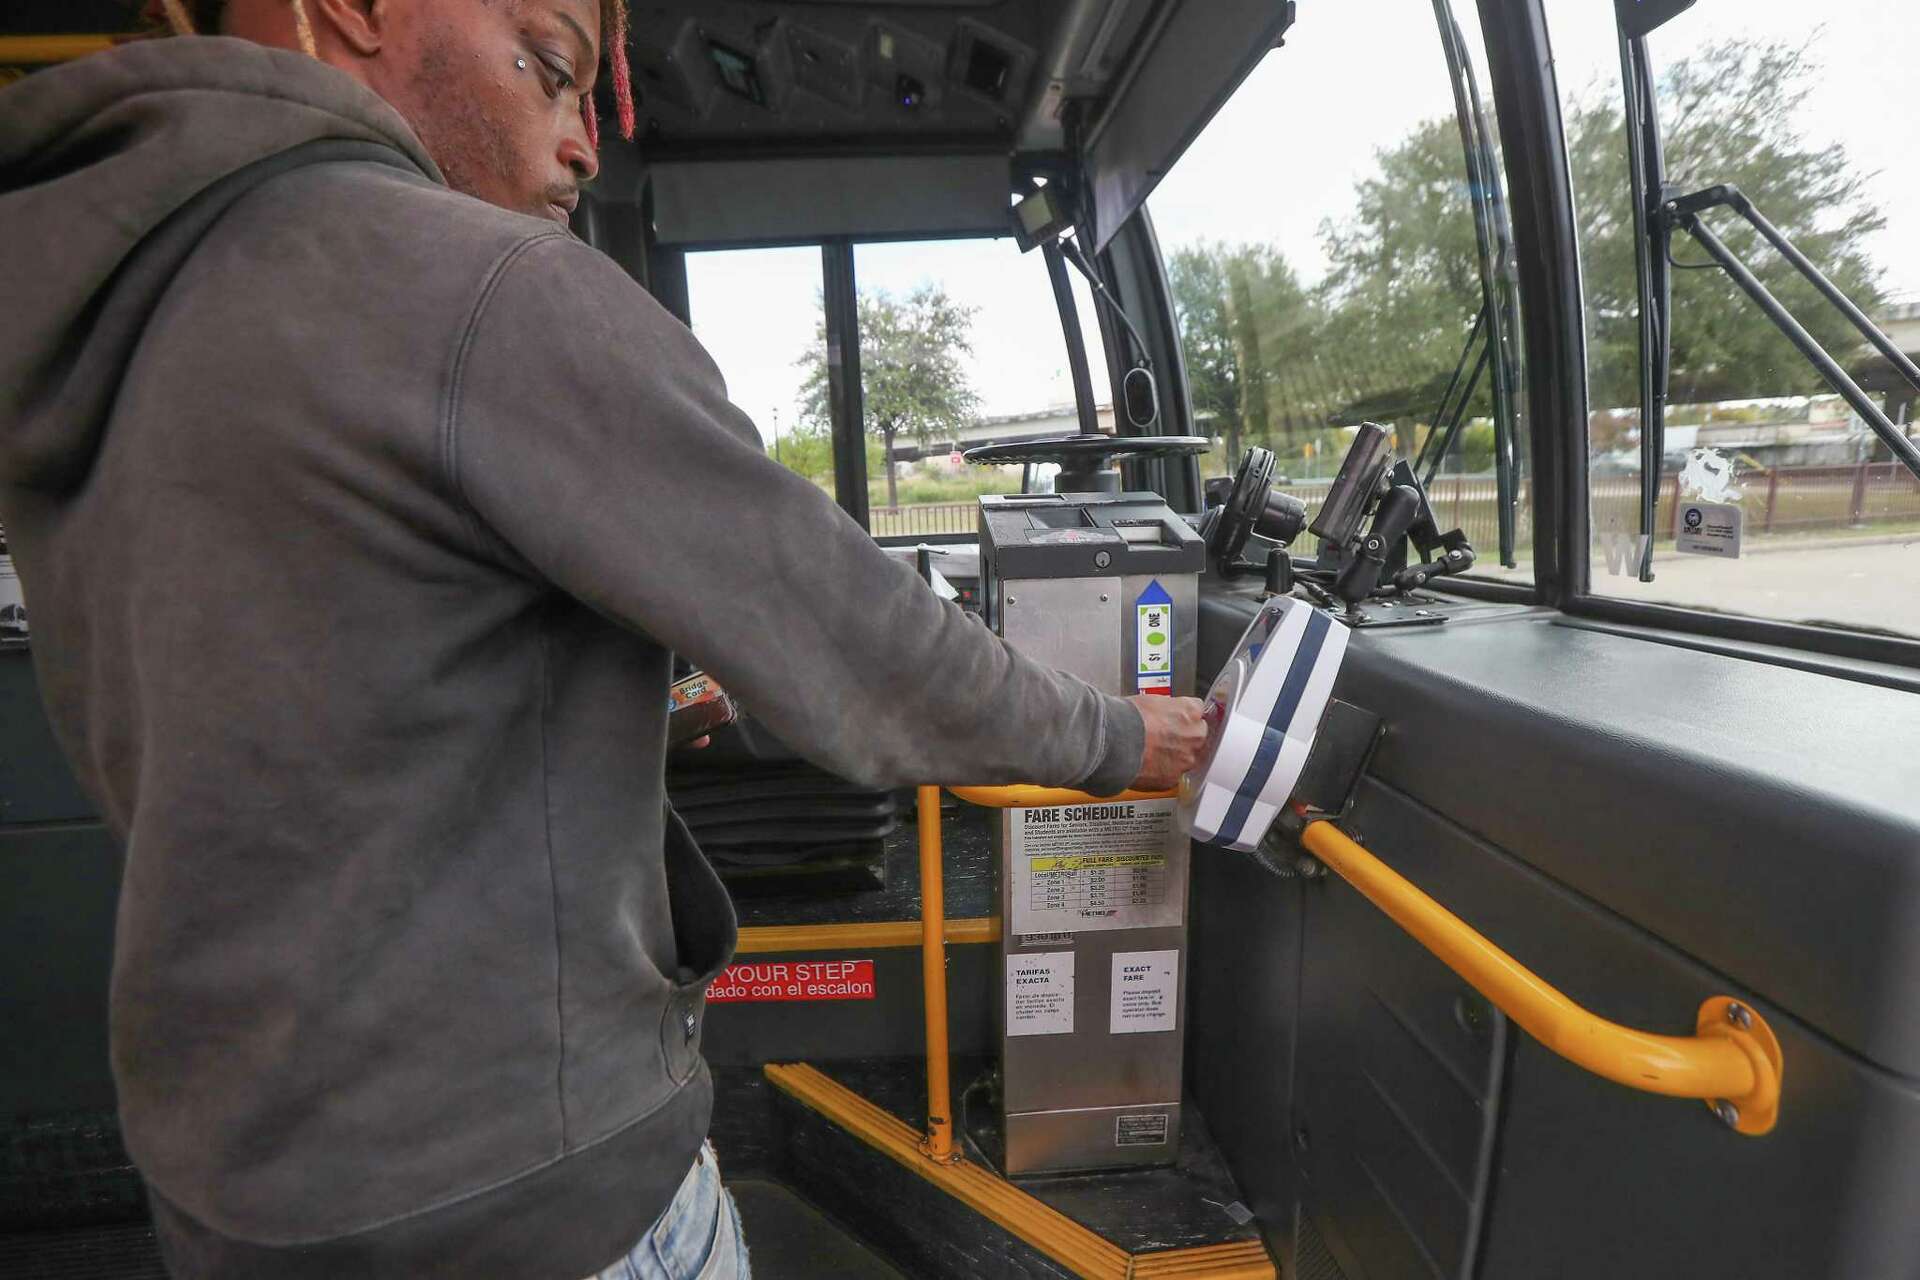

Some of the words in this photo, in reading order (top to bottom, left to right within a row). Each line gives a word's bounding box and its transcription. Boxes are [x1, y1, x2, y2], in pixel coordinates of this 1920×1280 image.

[1148, 612, 1161, 628] ONE
[679, 679, 708, 695] Bridge
[685, 687, 707, 699] Card
[1024, 808, 1060, 823] FARE
[1064, 805, 1135, 821] SCHEDULE
[725, 965, 789, 983] YOUR
[796, 963, 856, 980] STEP
[1016, 968, 1050, 976] TARIFAS
[1016, 977, 1050, 985] EXACTA
[705, 984, 746, 999] dado
[751, 986, 782, 996] con
[787, 982, 802, 996] el
[807, 980, 872, 996] escalon
